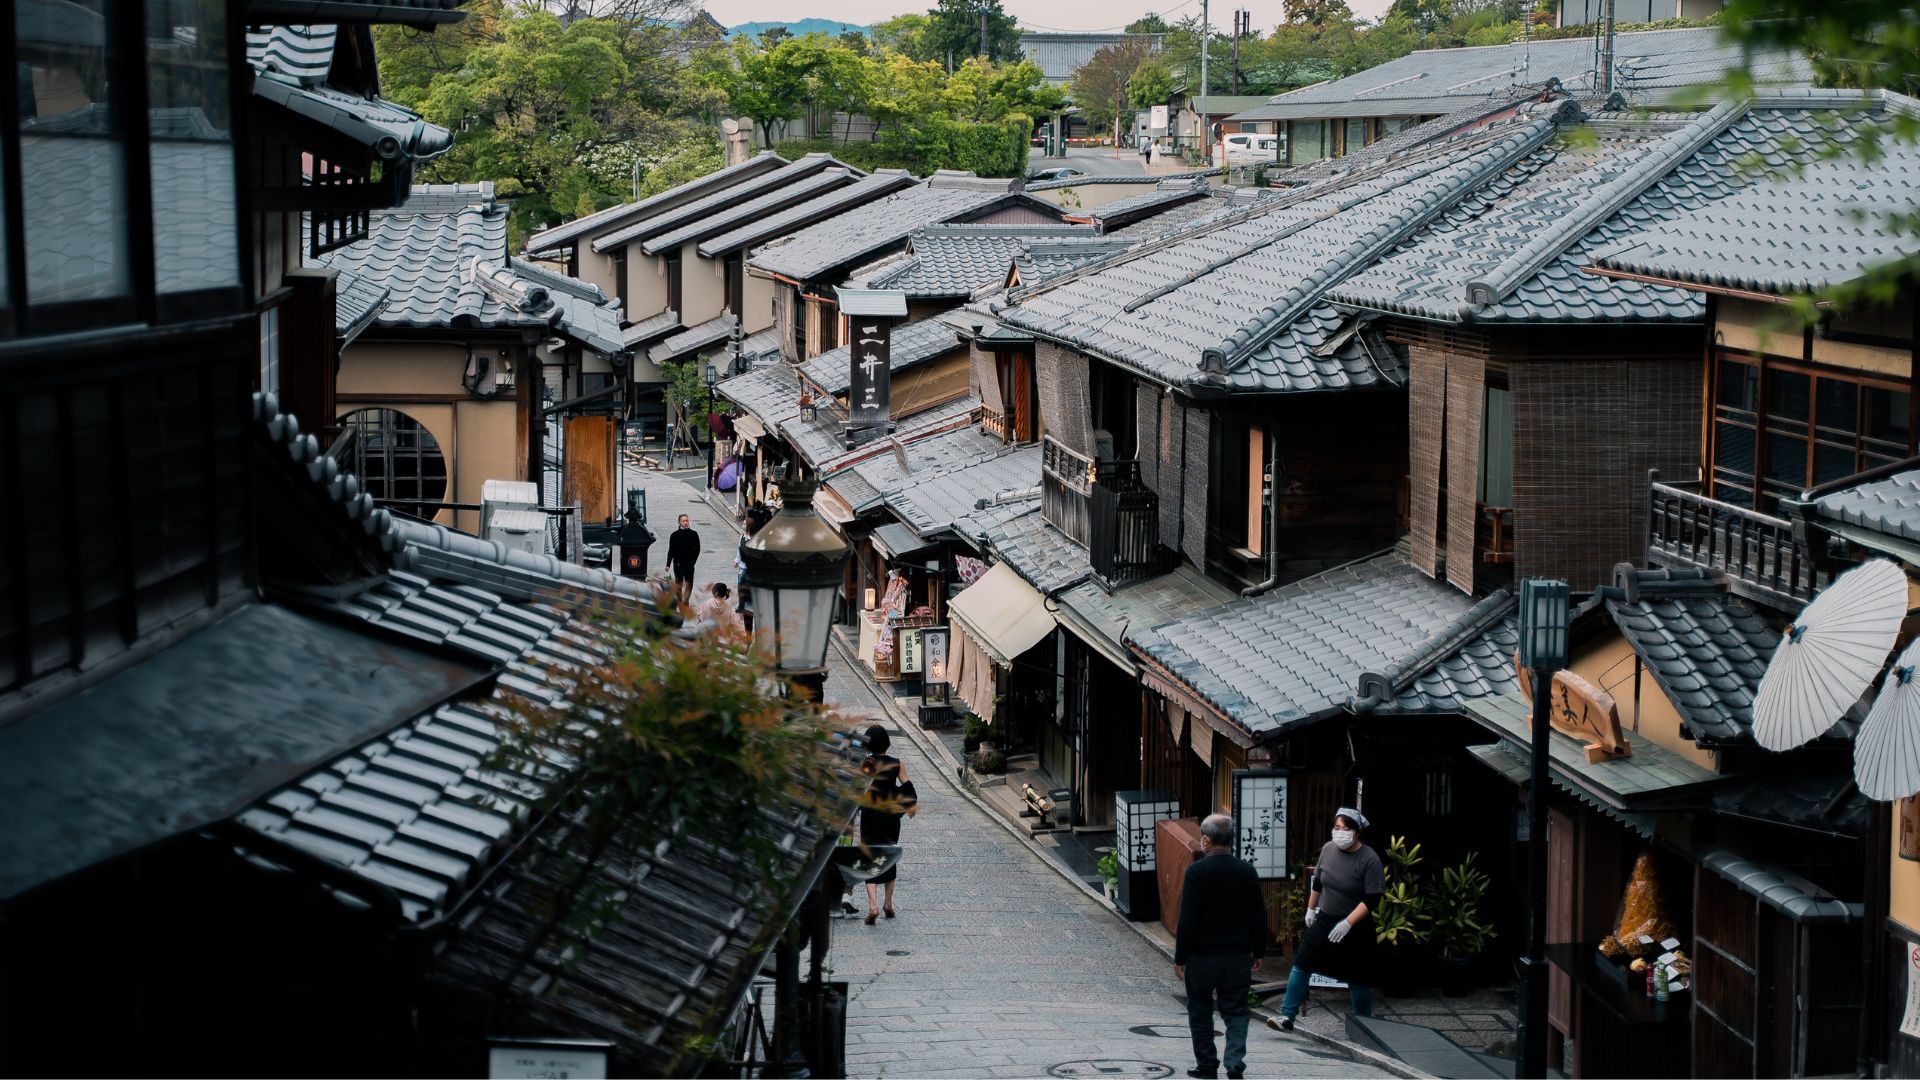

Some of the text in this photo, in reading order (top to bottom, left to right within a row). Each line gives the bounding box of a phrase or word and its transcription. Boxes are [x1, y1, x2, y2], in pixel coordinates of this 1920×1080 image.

[859, 325, 885, 409] 二井三
[1274, 785, 1286, 823] そば処
[1258, 809, 1270, 847] 二寧坂
